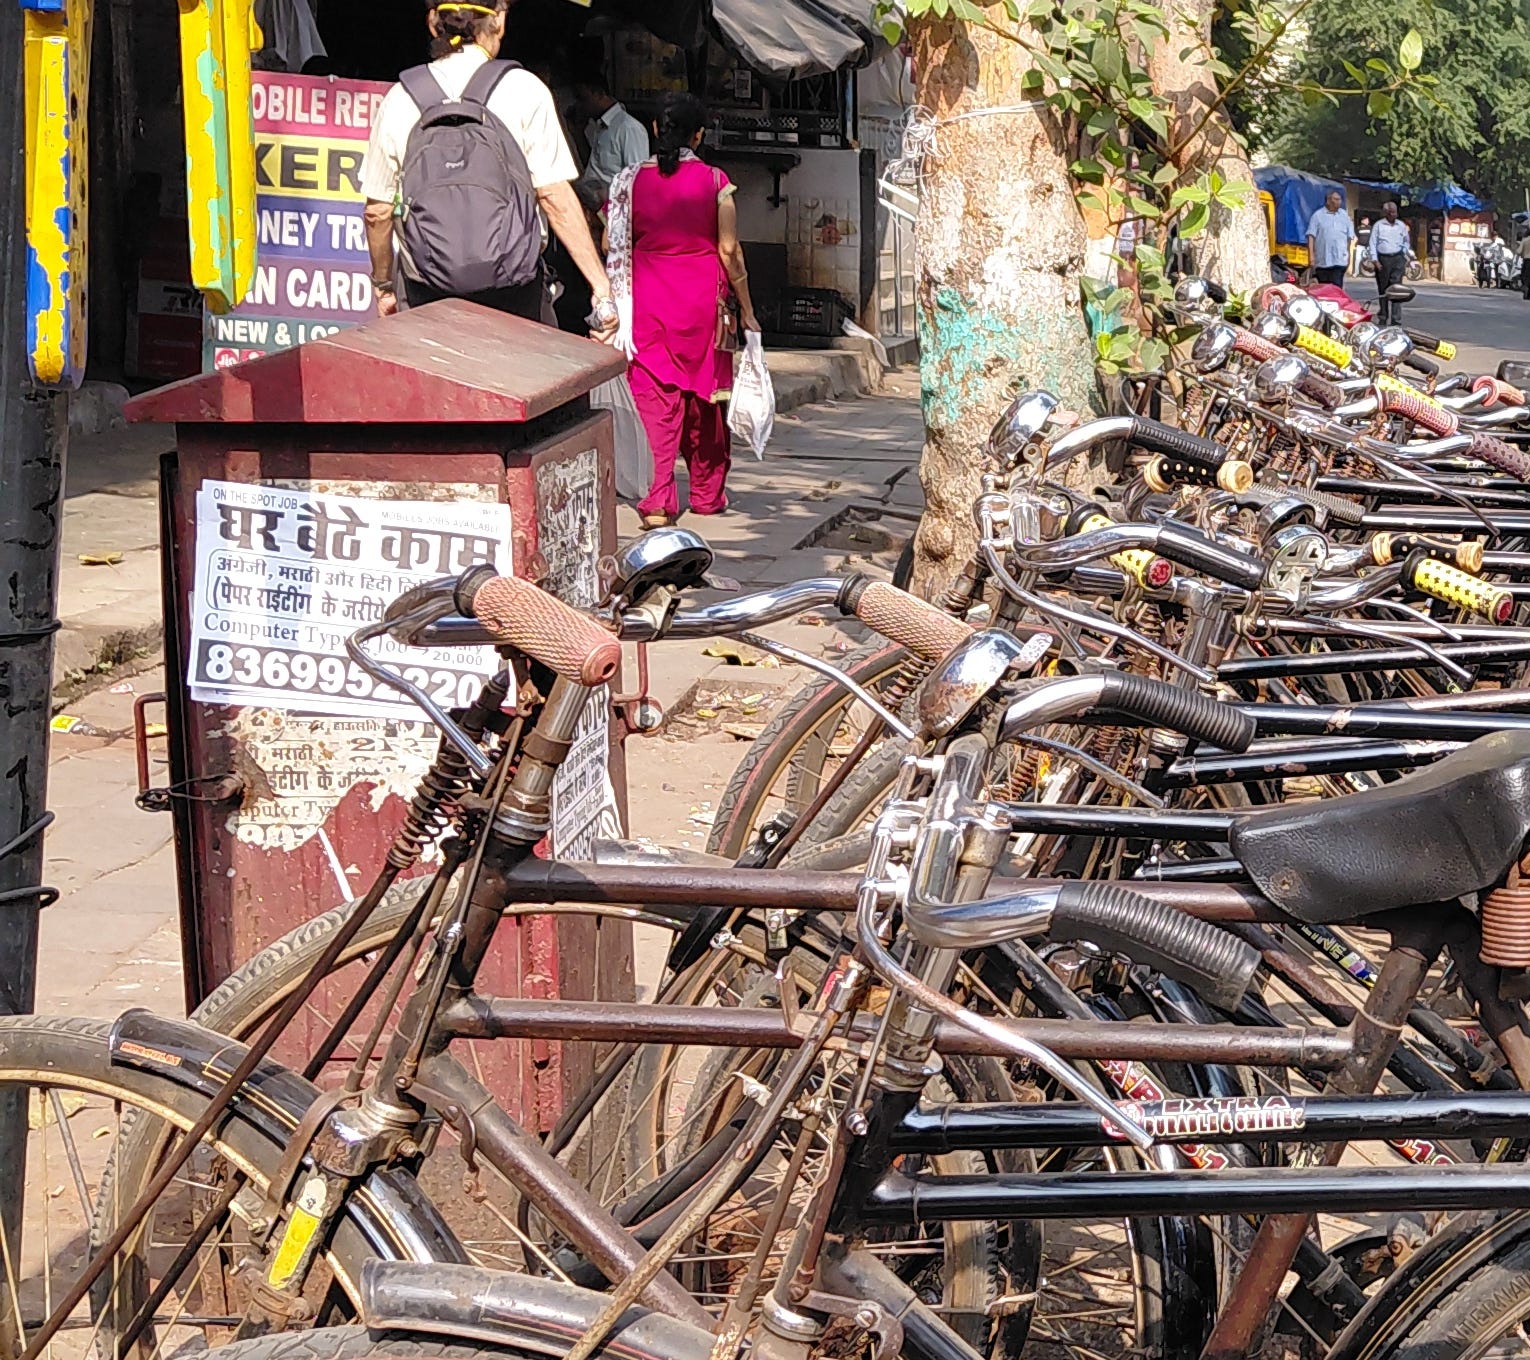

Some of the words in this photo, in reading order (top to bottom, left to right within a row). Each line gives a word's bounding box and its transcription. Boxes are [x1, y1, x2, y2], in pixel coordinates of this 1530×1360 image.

[251, 83, 327, 125] OBILE
[286, 268, 373, 312] CARD
[218, 319, 269, 344] NEW
[274, 323, 291, 346] &
[213, 488, 227, 501] ON
[229, 490, 248, 504] THE
[249, 492, 276, 508] SPOT
[277, 496, 298, 510] JOB
[217, 503, 285, 553] घर
[297, 500, 370, 561] बैठे
[381, 524, 501, 575] काम
[278, 565, 320, 585] मराठी
[324, 570, 354, 588] और
[321, 591, 339, 617] के
[204, 613, 299, 642] Computer
[433, 650, 483, 666] 20,000
[1162, 1096, 1291, 1116] EXTRA
